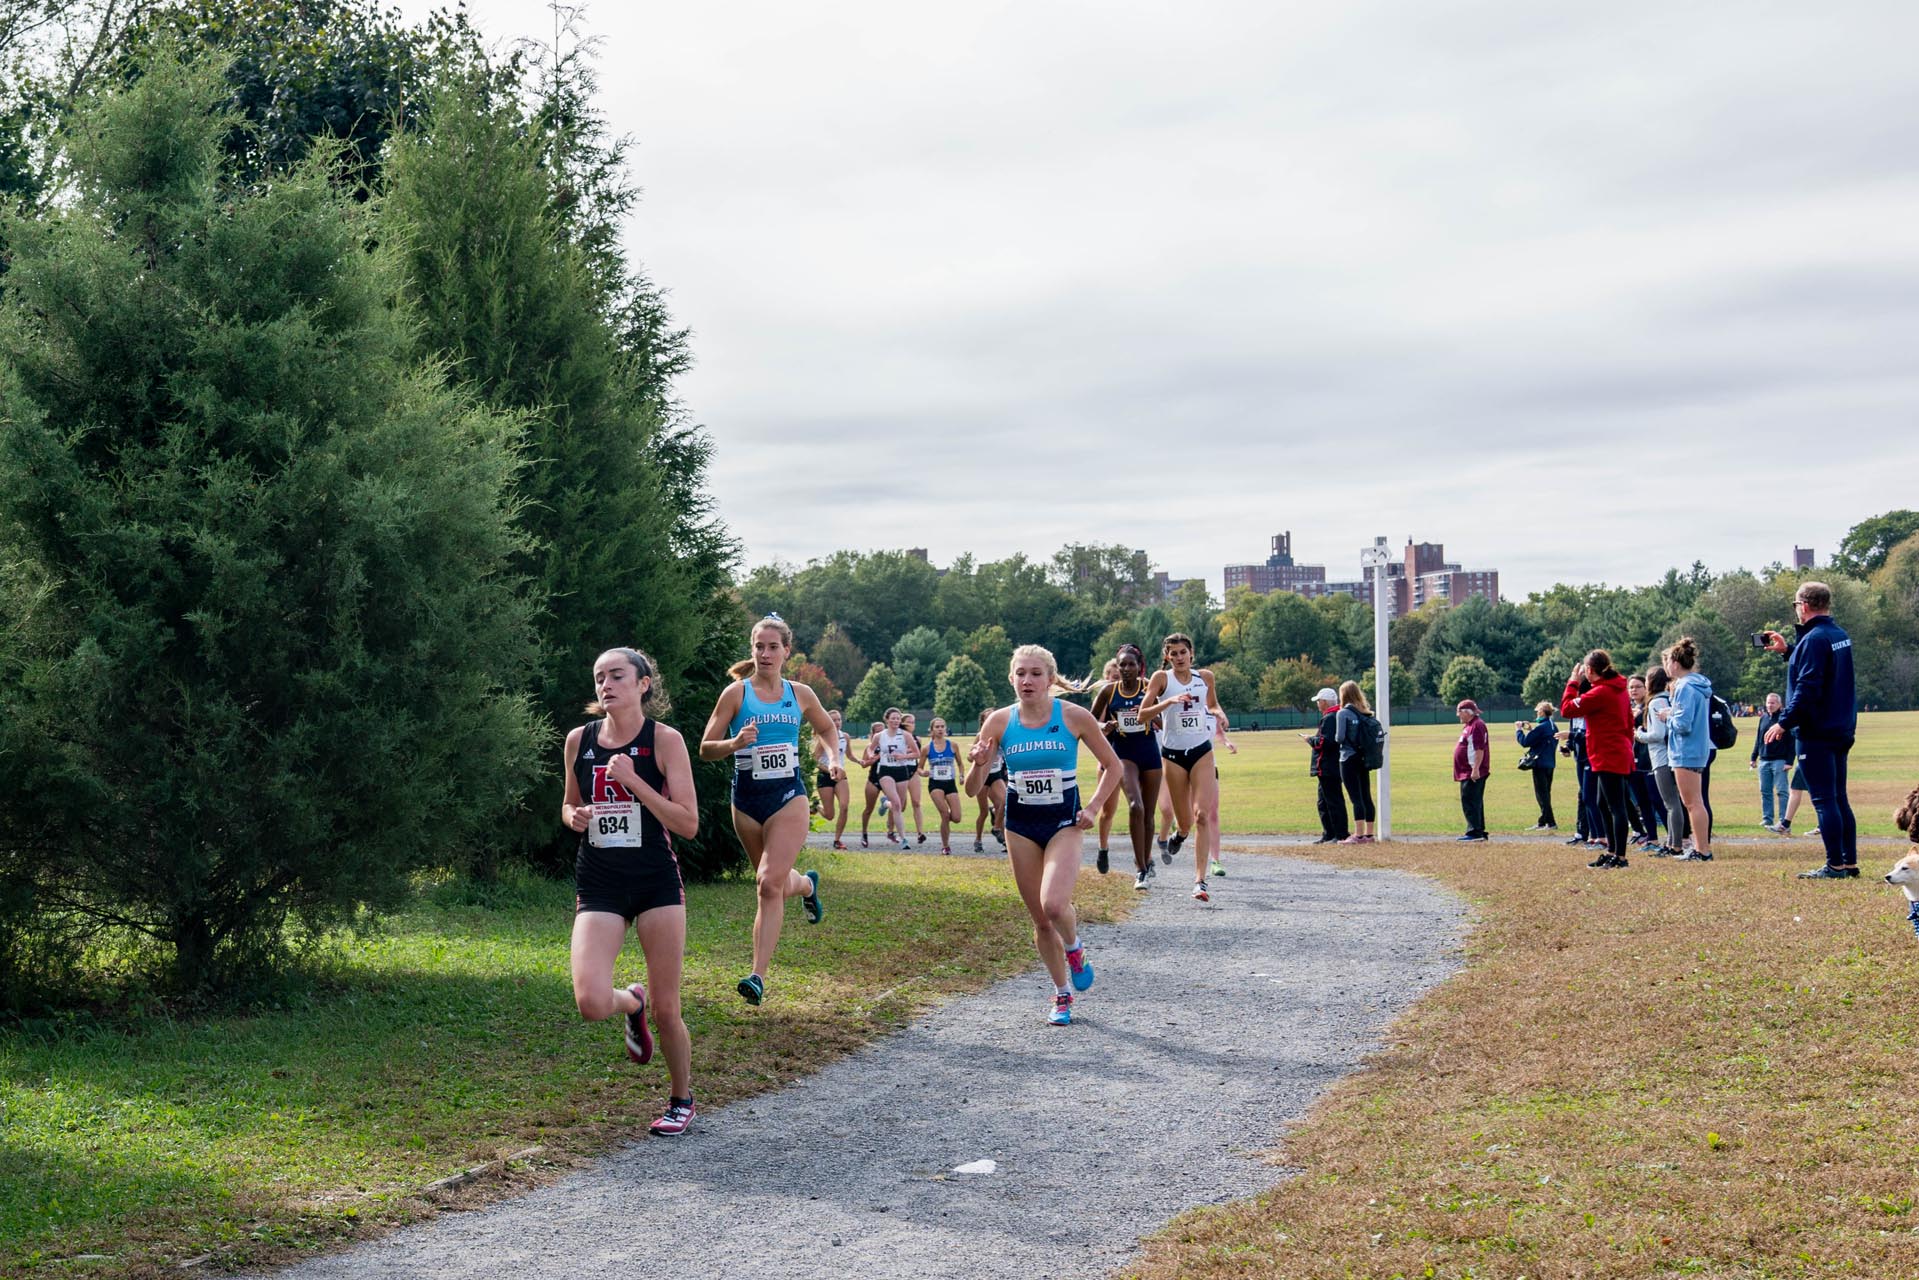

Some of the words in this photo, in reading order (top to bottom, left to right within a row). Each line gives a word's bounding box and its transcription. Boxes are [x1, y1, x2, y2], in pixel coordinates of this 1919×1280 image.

[744, 713, 798, 726] COLUMBIA
[1182, 717, 1199, 728] 521
[1006, 740, 1066, 755] COLUMBIA
[761, 754, 787, 769] 503
[1025, 779, 1053, 794] 504
[598, 815, 630, 835] 634
